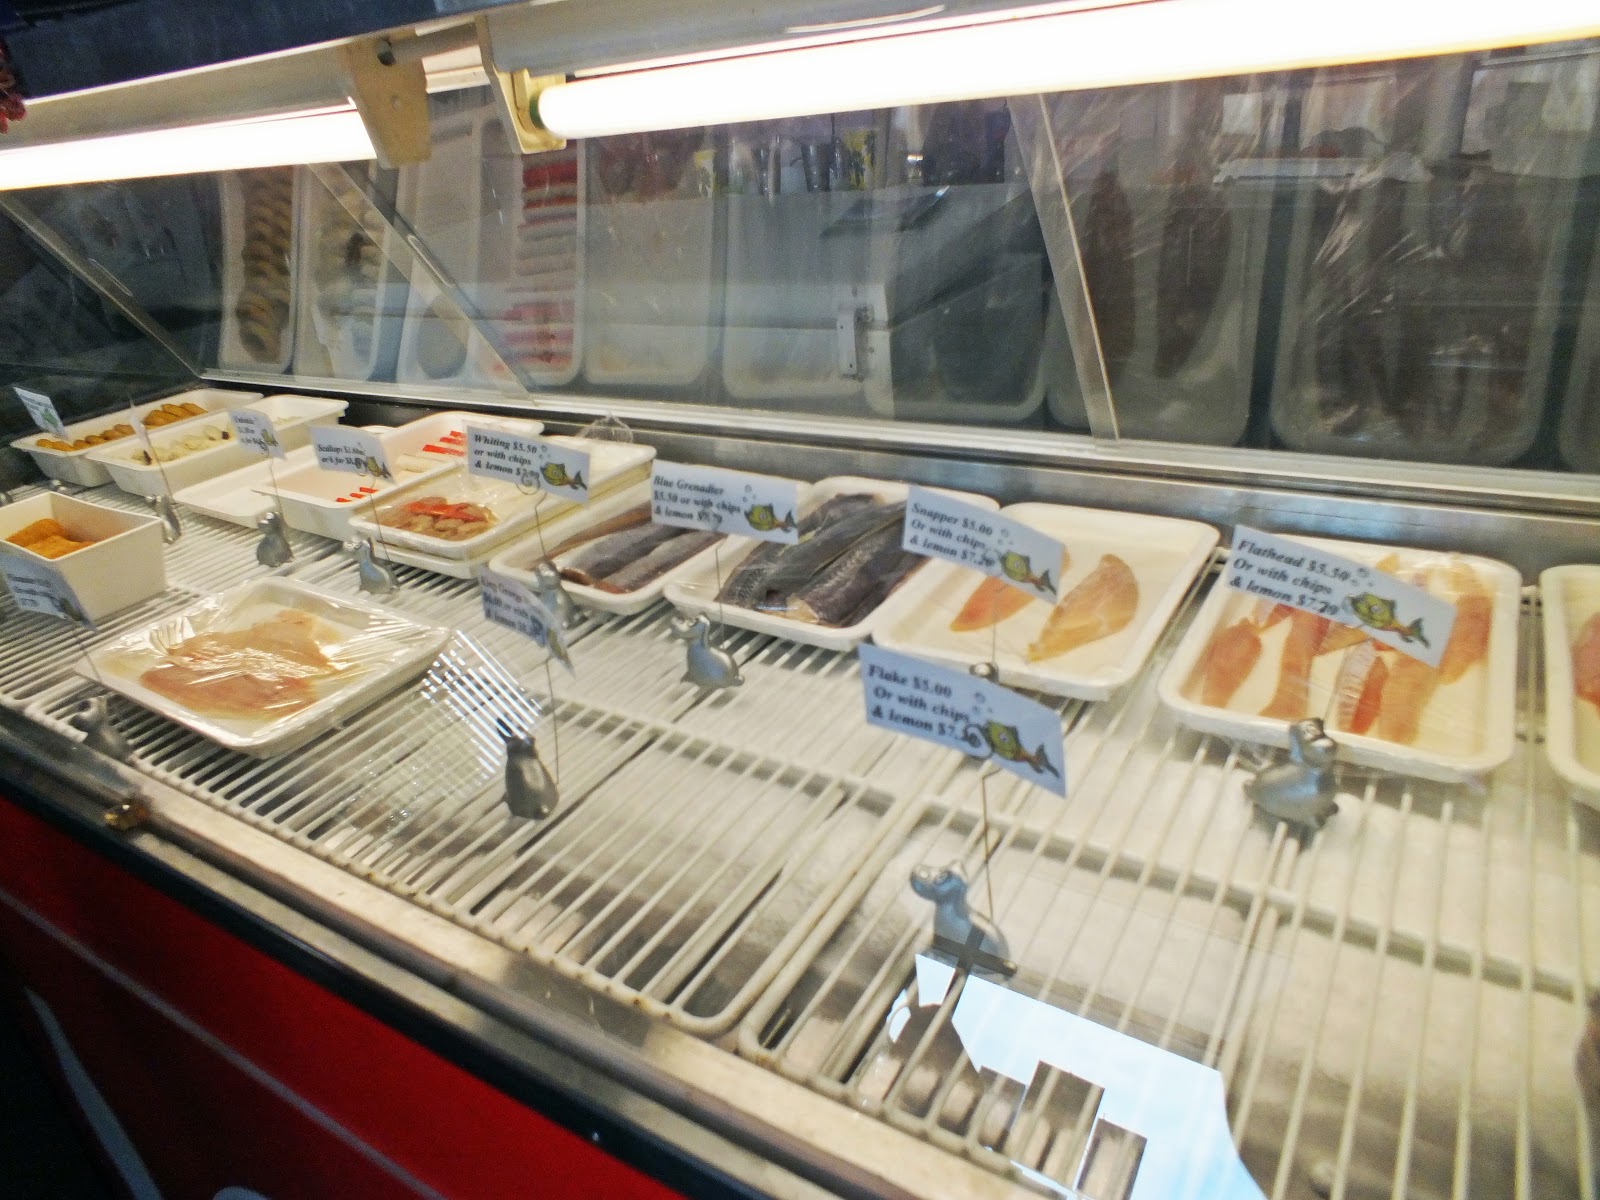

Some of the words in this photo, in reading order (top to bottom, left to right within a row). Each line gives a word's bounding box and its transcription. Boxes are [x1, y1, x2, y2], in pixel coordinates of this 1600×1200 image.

[474, 433, 511, 450] Whiting
[474, 449, 484, 457] or
[487, 450, 506, 460] with
[508, 453, 531, 466] chips
[475, 460, 482, 468] &
[485, 461, 513, 475] lemon
[676, 479, 724, 496] Grenadier
[665, 506, 694, 520] lemon
[911, 502, 959, 525] Snapper
[961, 517, 993, 537] $5.00
[909, 534, 919, 545] &
[923, 537, 957, 556] lemon
[911, 519, 926, 531] Or
[929, 526, 952, 539] with
[956, 530, 986, 550] chips
[1237, 539, 1305, 568] Flathead
[1229, 575, 1241, 588] &
[1246, 580, 1294, 602] lemon
[1233, 558, 1253, 571] Or
[1256, 565, 1289, 582] with
[1292, 576, 1333, 594] chips
[868, 663, 908, 686] Flake
[913, 675, 953, 698] $5.00
[873, 685, 893, 700] Or
[897, 694, 927, 711] with
[931, 700, 970, 722] chips
[871, 705, 884, 719] &
[888, 709, 934, 731] lemon
